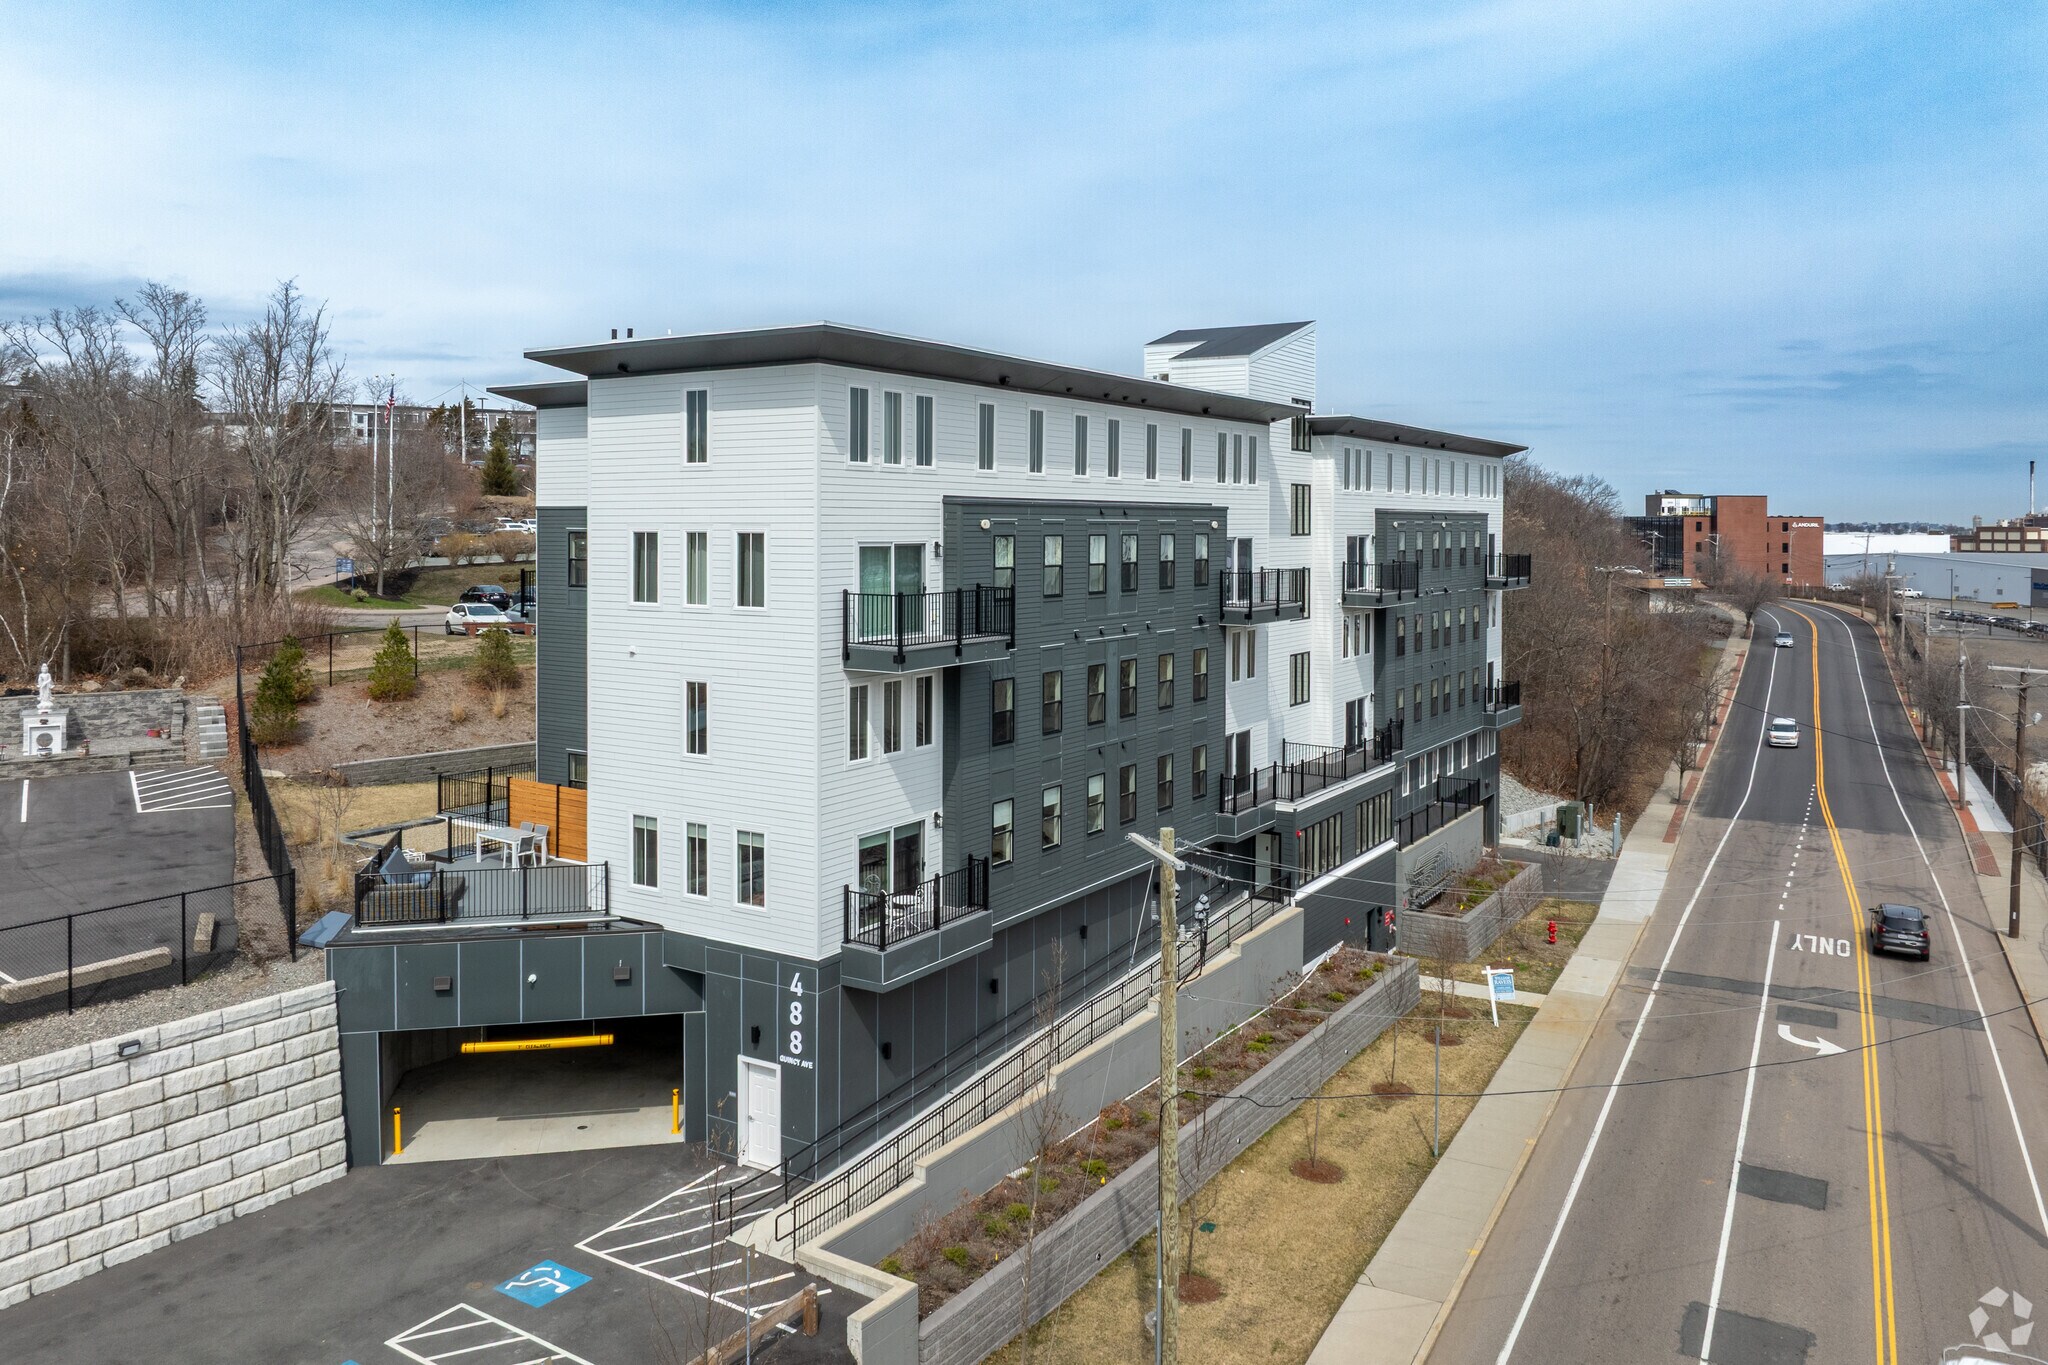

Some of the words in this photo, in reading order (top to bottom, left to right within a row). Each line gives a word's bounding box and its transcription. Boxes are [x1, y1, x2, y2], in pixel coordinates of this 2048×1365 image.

[1791, 934, 1851, 957] ONLY
[789, 972, 803, 1055] 488
[779, 1054, 801, 1066] QUINCY
[801, 1060, 813, 1069] AVE
